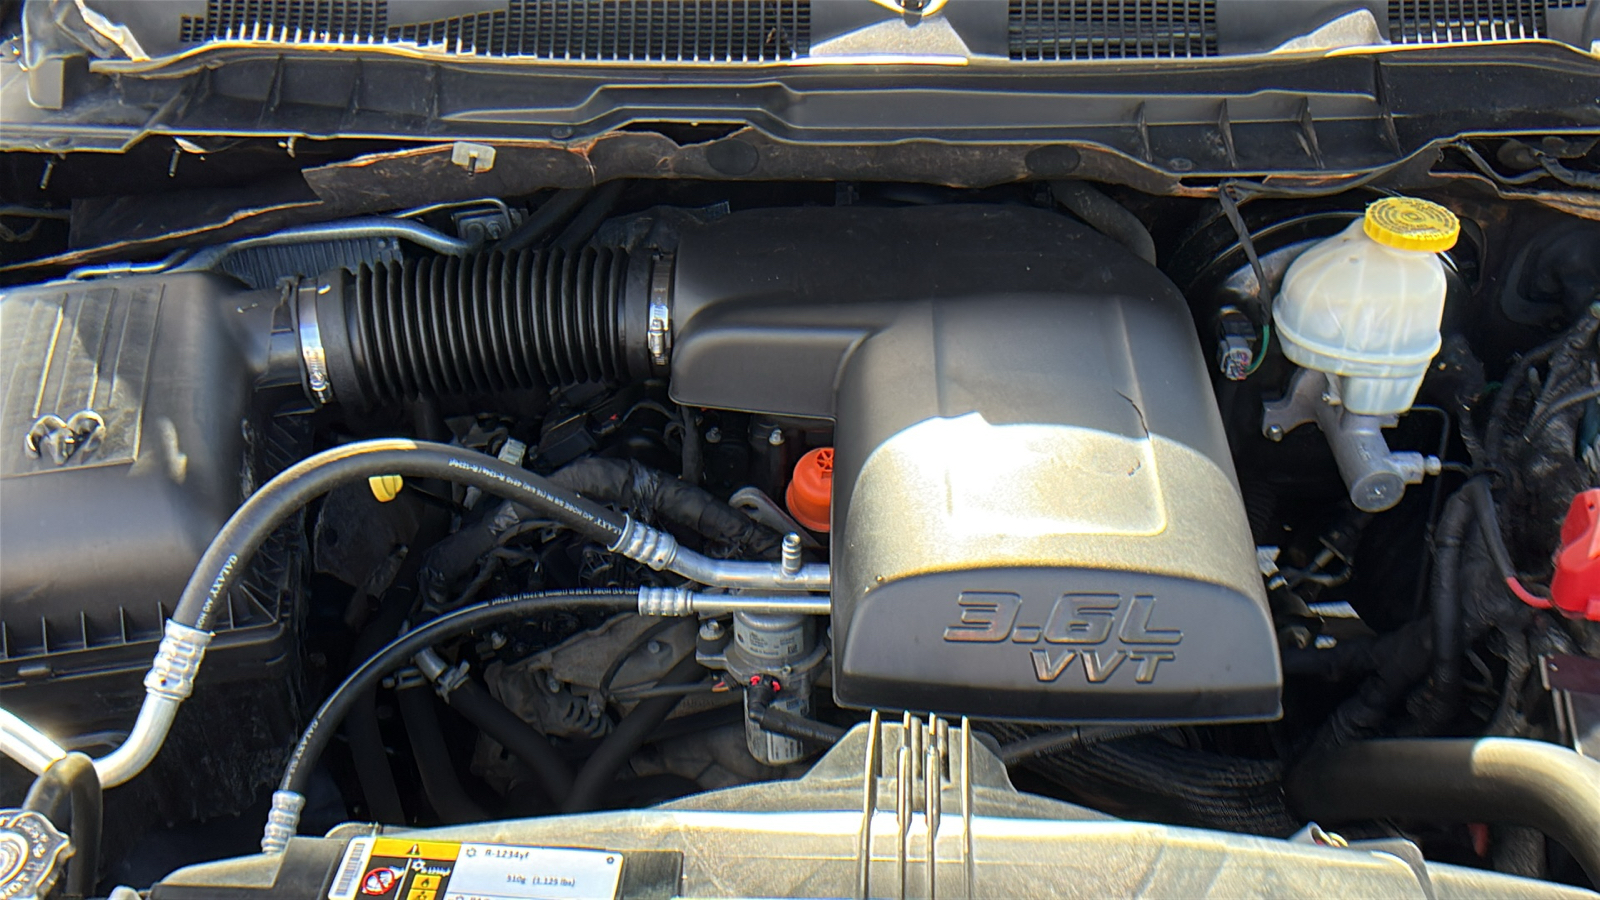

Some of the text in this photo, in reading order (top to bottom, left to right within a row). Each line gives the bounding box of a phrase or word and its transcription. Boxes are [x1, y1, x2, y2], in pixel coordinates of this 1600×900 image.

[209, 553, 239, 598] GALAXY
[943, 590, 1184, 645] 3.6L
[1029, 648, 1177, 684] VVT
[484, 849, 530, 861] R-1234yf
[506, 874, 526, 885] 510g
